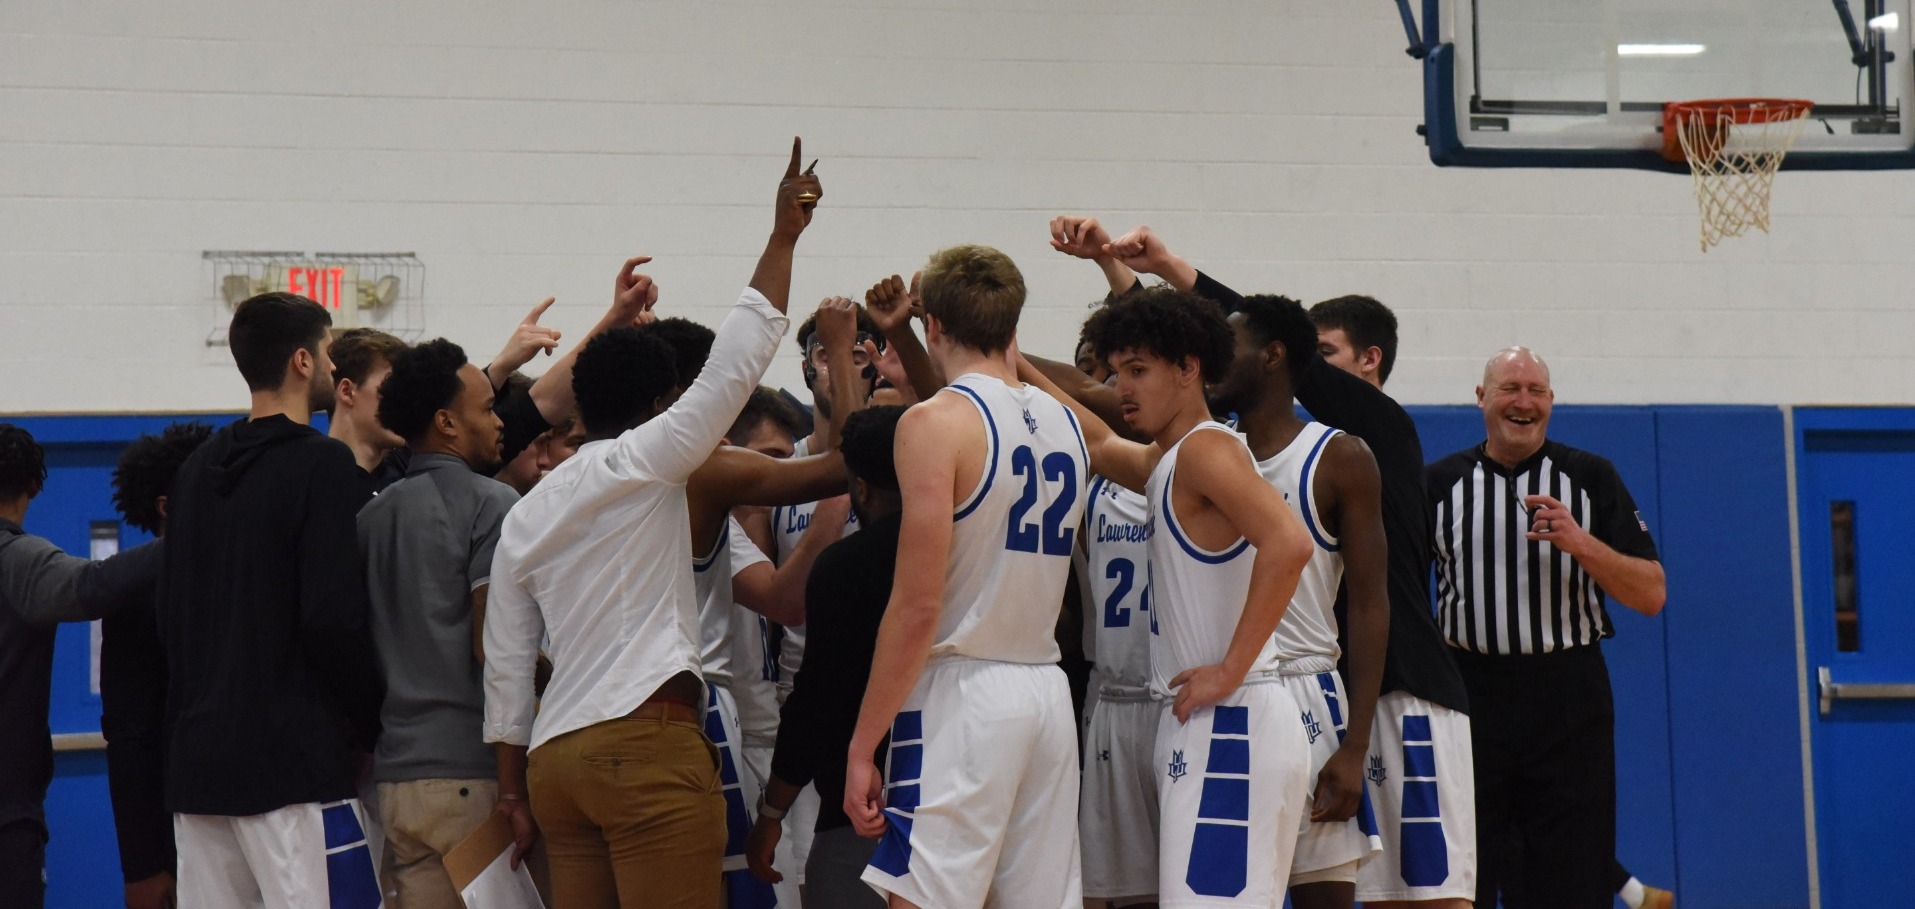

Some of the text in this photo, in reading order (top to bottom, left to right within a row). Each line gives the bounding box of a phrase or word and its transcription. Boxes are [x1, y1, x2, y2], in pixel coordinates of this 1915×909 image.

[288, 266, 345, 308] EXIT
[1005, 444, 1077, 556] 22
[1097, 513, 1147, 543] Lawren
